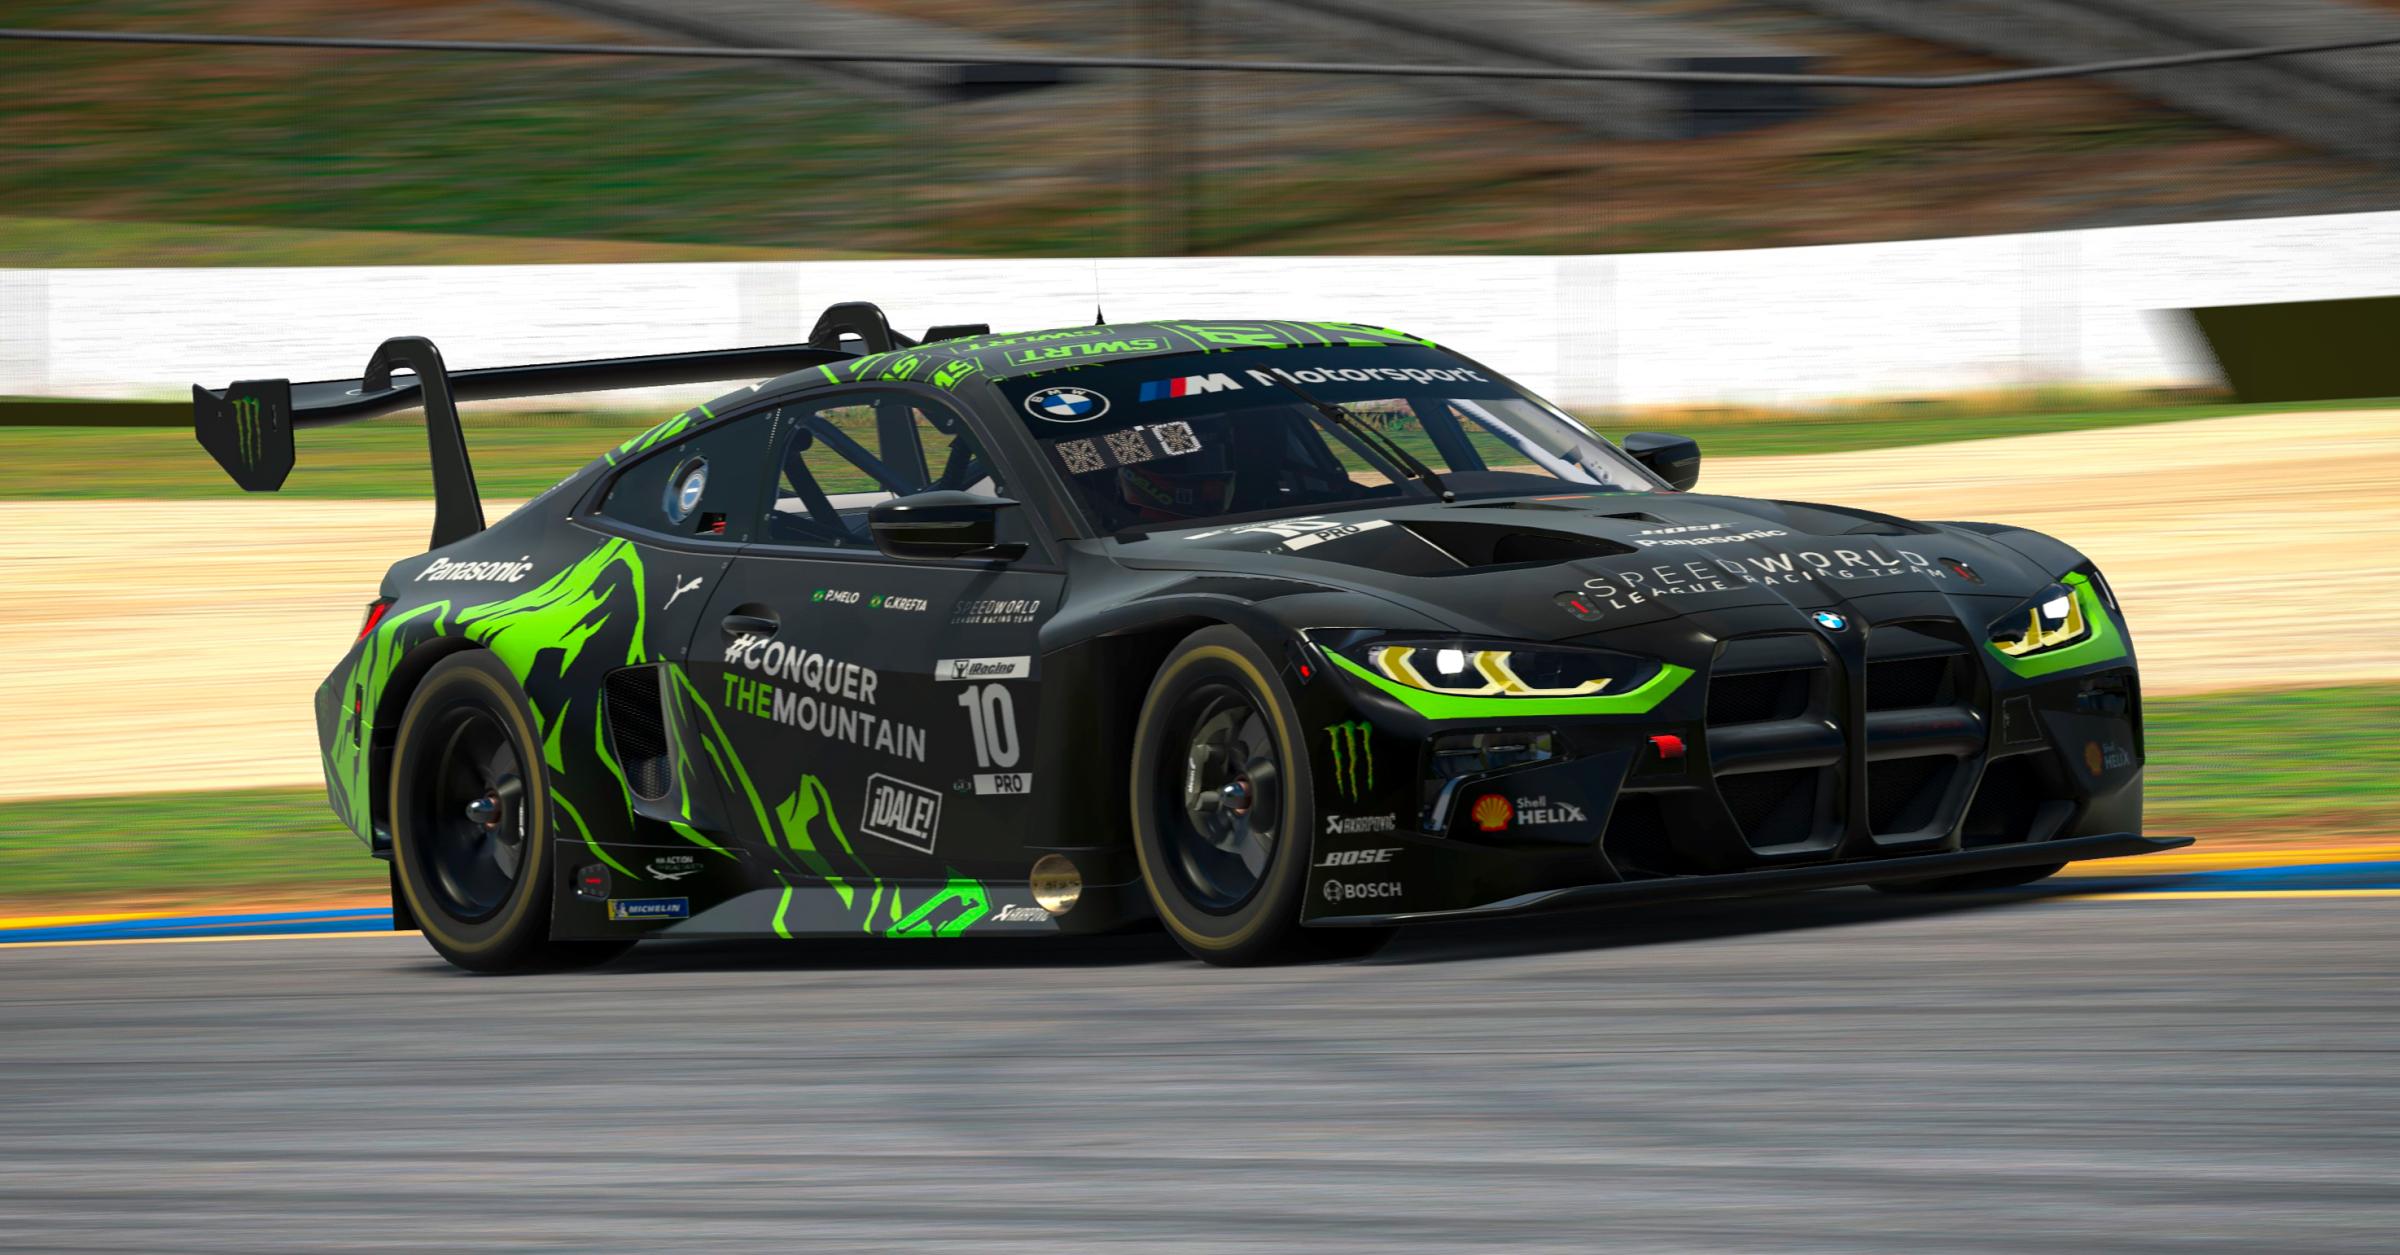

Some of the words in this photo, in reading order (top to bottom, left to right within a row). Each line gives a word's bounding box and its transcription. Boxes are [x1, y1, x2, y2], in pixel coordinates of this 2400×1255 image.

[1019, 338, 1158, 363] SWLRT
[1246, 366, 1489, 387] Motorsport
[1030, 388, 1086, 404] BMW
[1315, 525, 1361, 542] PRO
[1634, 529, 1788, 547] Panasonic
[414, 555, 533, 583] Panasonic
[1584, 548, 1930, 598] SPEEDWORLD
[824, 589, 860, 604] P.MELO
[1610, 580, 1727, 610] LEAGUE
[1743, 567, 1855, 586] RACING
[1871, 565, 1946, 580] TEAM
[952, 599, 1041, 615] SPEEDWORLD
[724, 633, 878, 705] #CONQUER
[968, 661, 1016, 675] iRacing
[958, 682, 1020, 768] 10
[993, 774, 1023, 793] PRO
[1517, 796, 1547, 809] Shell
[1517, 802, 1588, 825] HELIX
[1314, 847, 1404, 867] BOSE
[1345, 881, 1403, 899] BOSCH
[628, 904, 681, 913] MICHELIN
